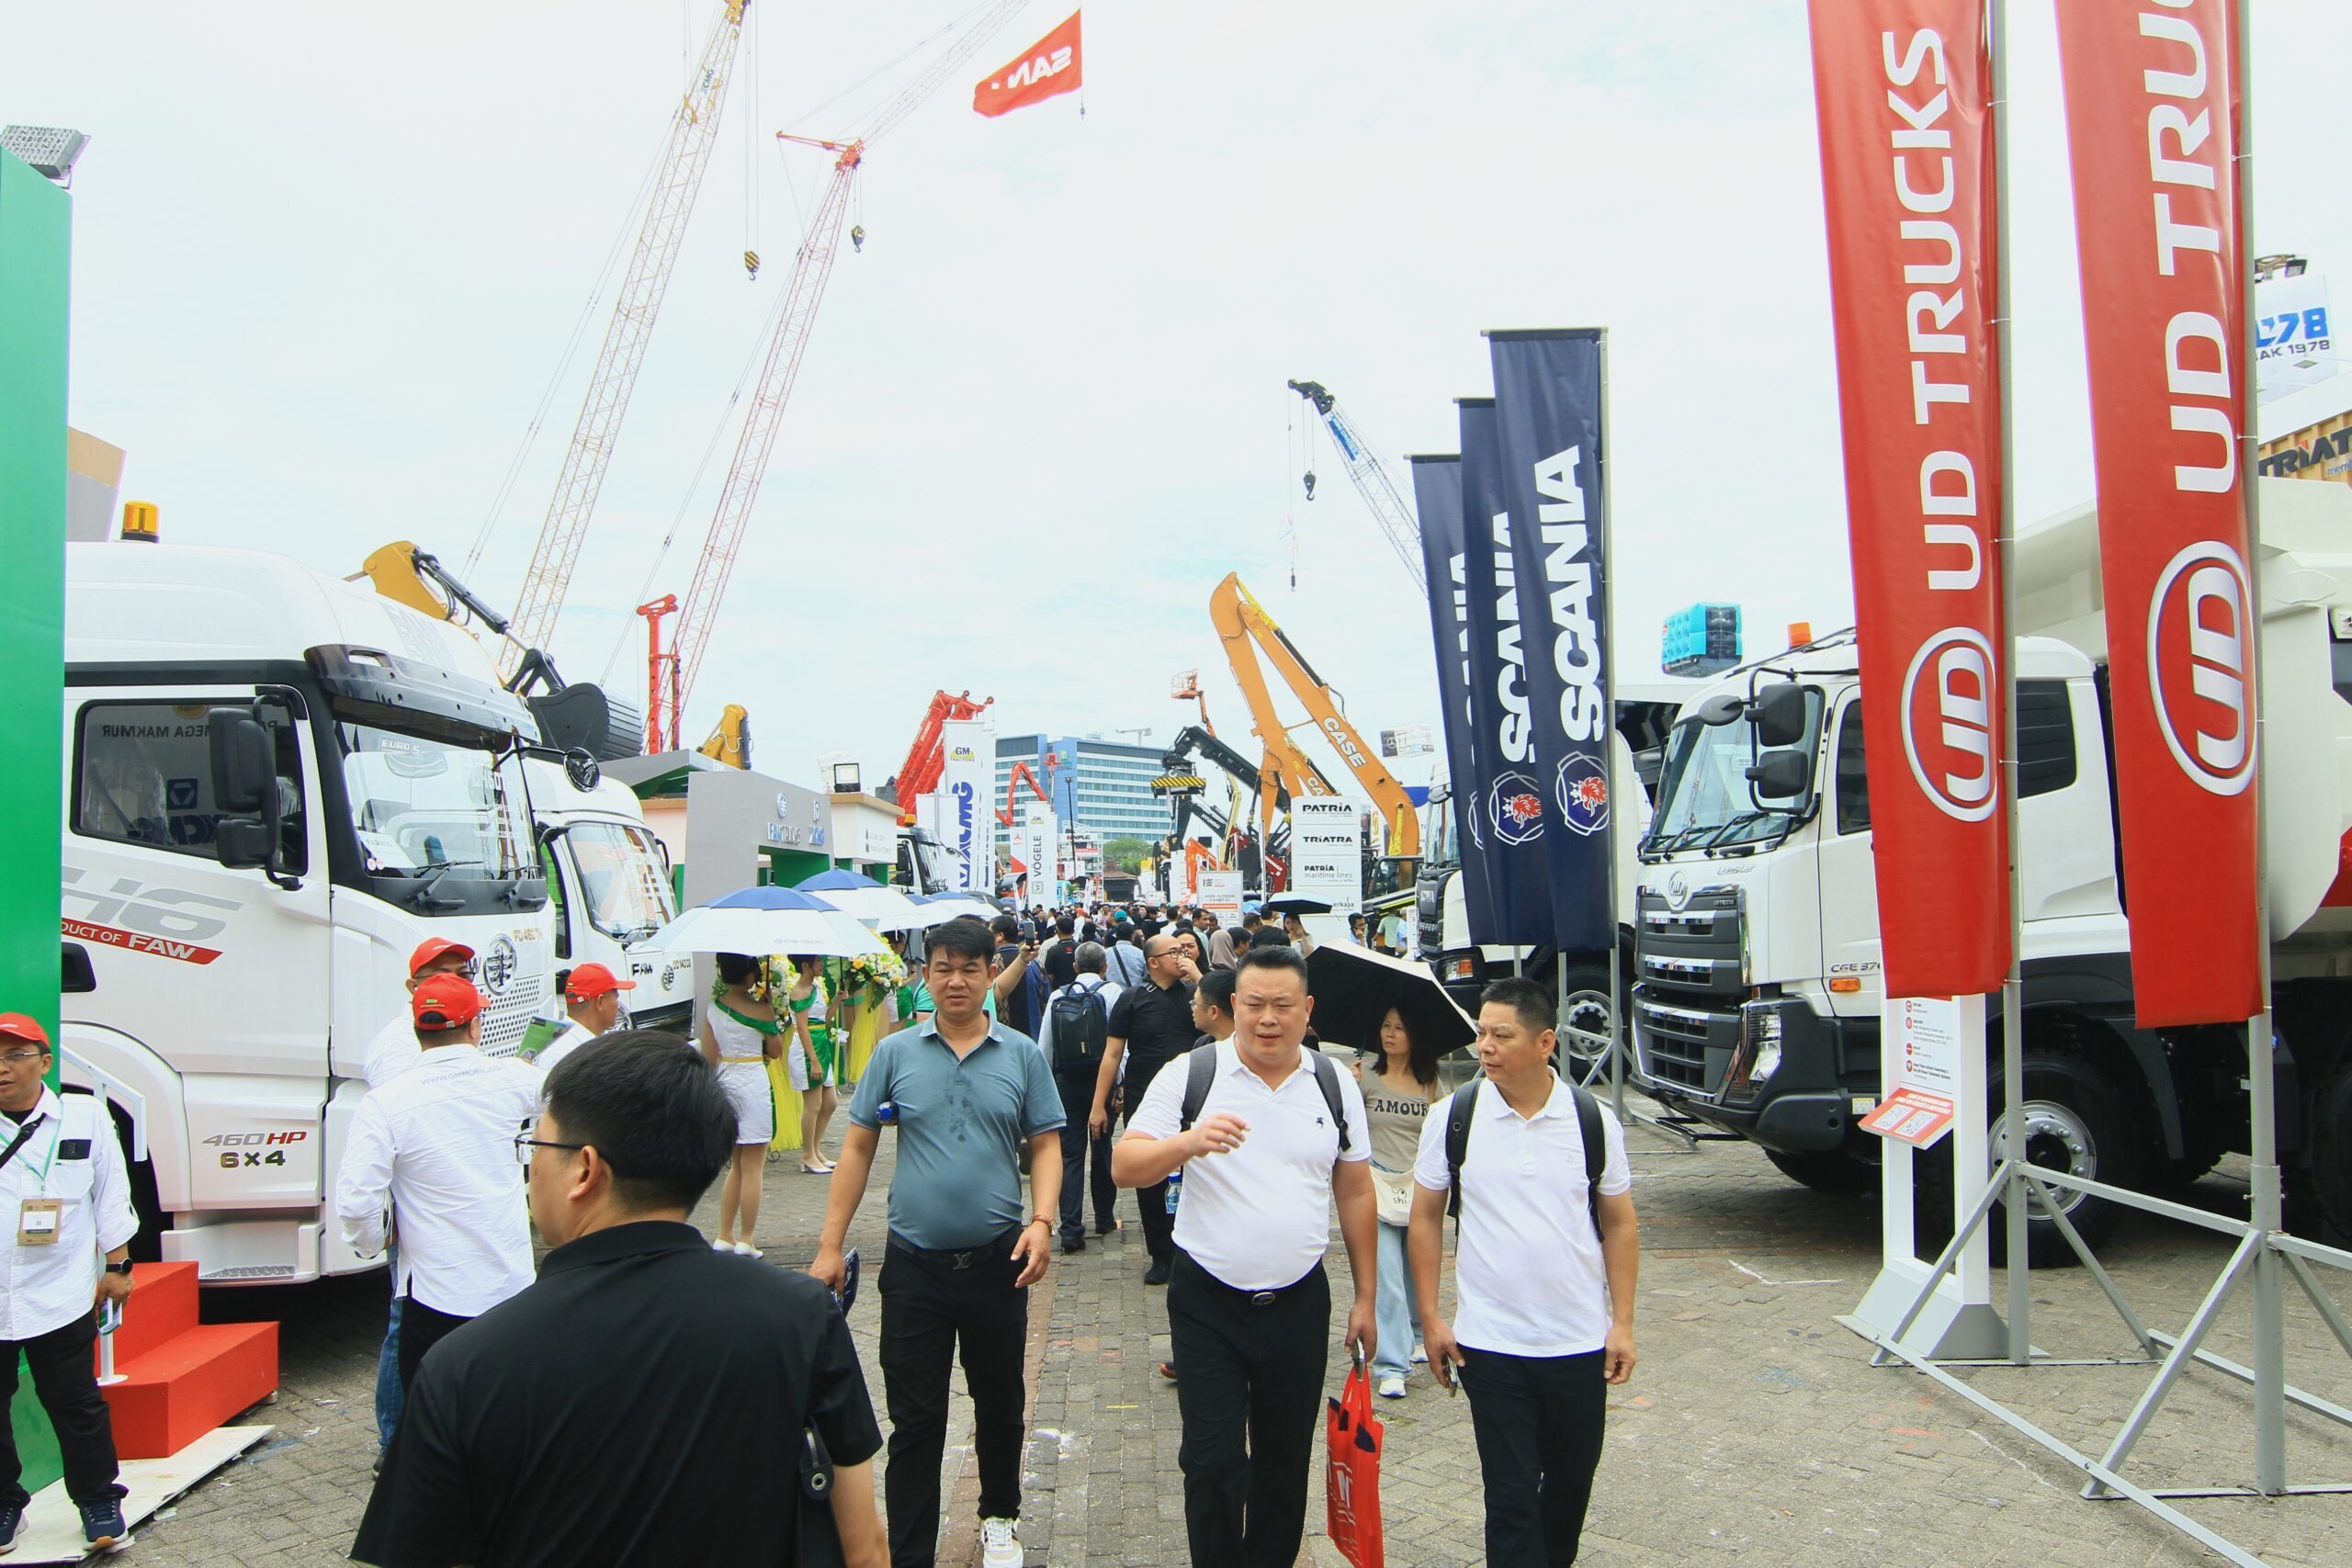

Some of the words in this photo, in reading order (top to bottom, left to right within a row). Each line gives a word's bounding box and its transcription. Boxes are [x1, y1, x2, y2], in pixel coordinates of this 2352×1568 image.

[2138, 0, 2220, 276] TRU
[1882, 28, 1970, 424] TRUCKS
[2256, 346, 2283, 360] AK
[2287, 340, 2331, 355] 1978
[2165, 311, 2235, 493] UD
[1919, 450, 1981, 590] UD
[1533, 444, 1604, 741] SCANIA
[380, 739, 411, 751] EURO
[412, 744, 421, 755] 5
[955, 746, 970, 756] GM
[1322, 716, 1367, 768] CASE
[1201, 813, 1221, 829] HYUNDAI
[1030, 835, 1042, 878] VÖGELE
[1305, 871, 1335, 879] maritime
[1337, 867, 1352, 879] lines
[1333, 897, 1354, 908] erkaja
[100, 931, 122, 943] OF
[128, 933, 197, 960] FAW
[632, 964, 653, 976] FAW
[1831, 963, 1858, 973] CGE
[1374, 1099, 1428, 1117] AMOUR
